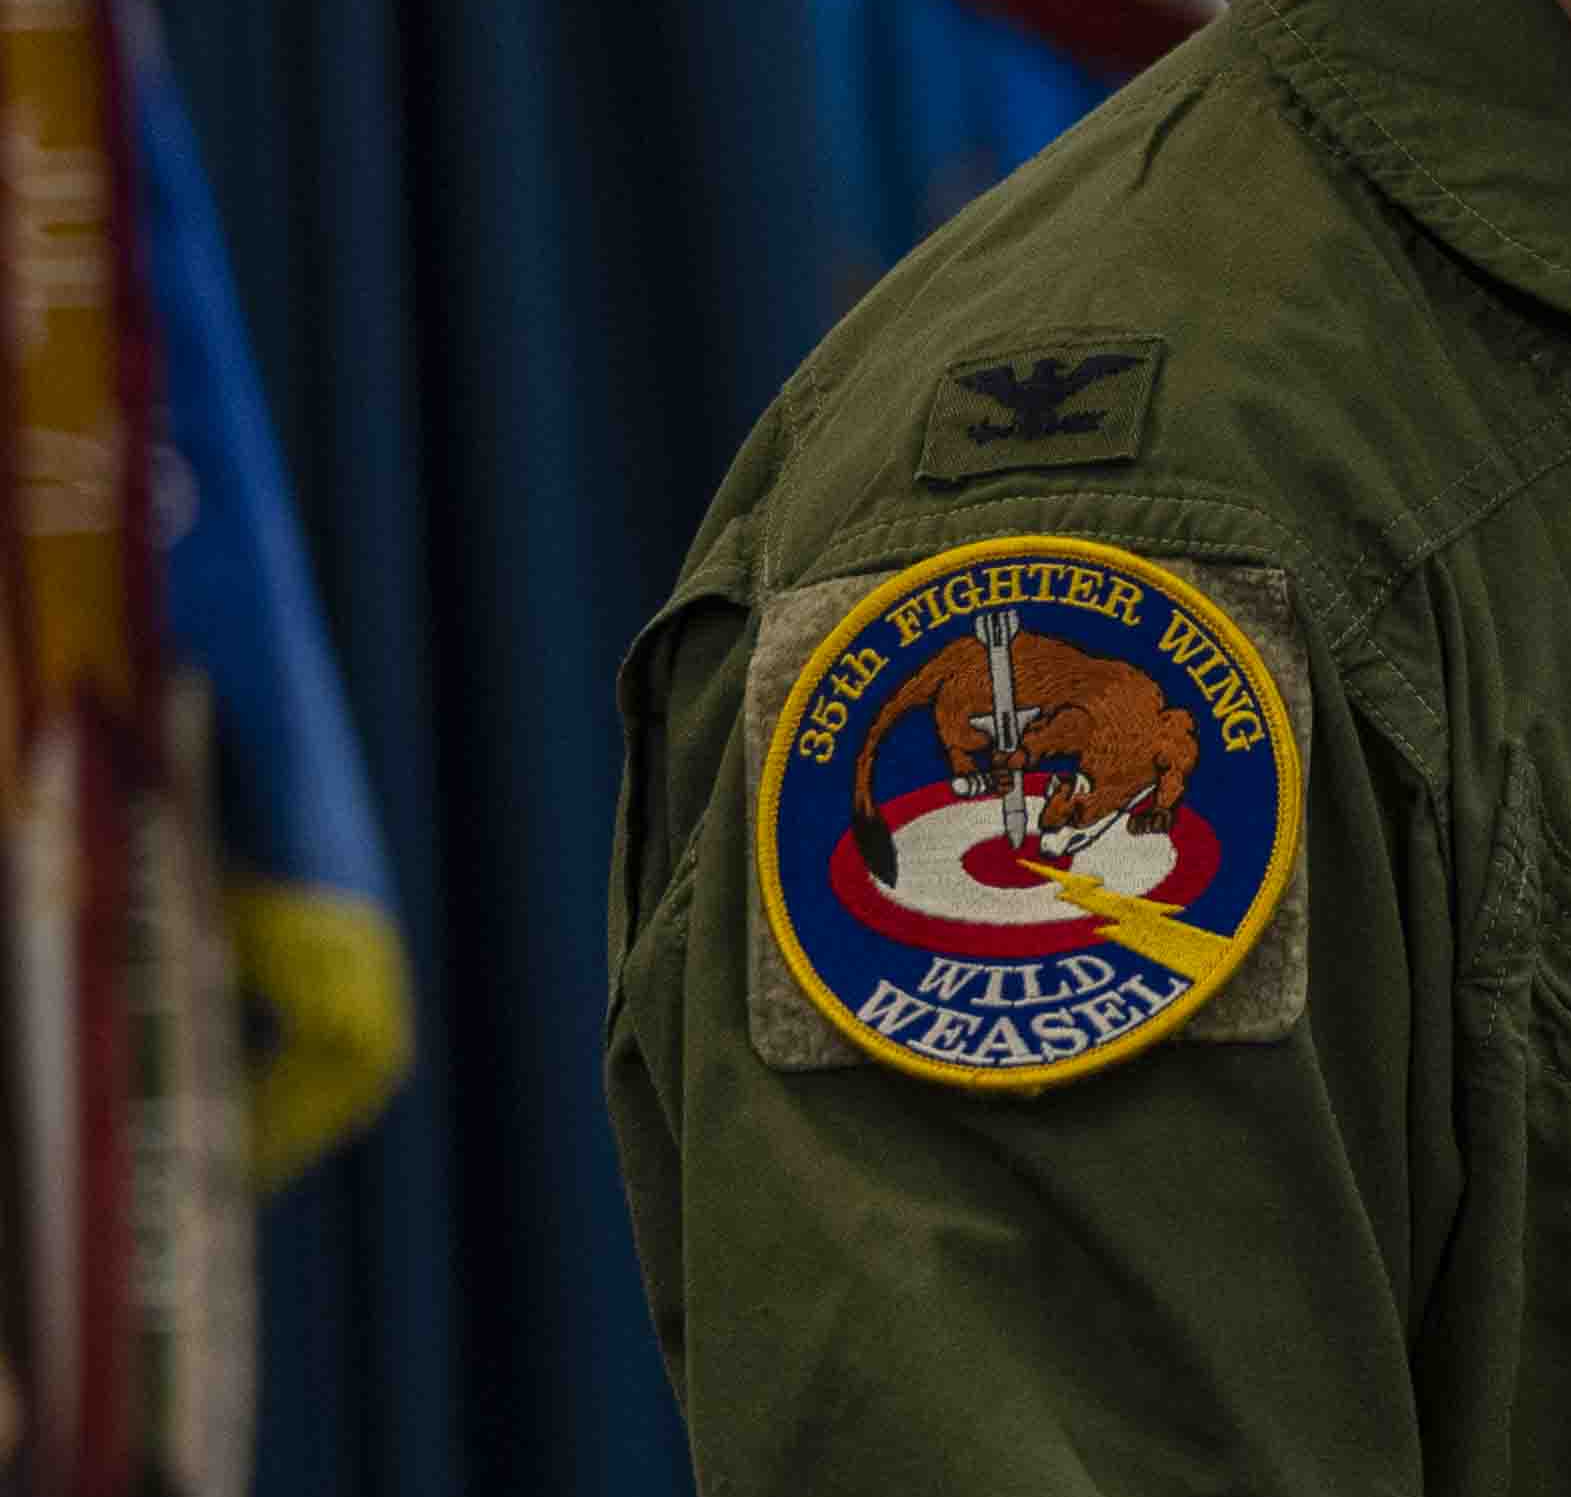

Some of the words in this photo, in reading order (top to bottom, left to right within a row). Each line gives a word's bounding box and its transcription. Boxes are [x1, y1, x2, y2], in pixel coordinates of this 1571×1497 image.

[799, 642, 890, 766] 35th
[884, 562, 1145, 649] FIGHTER
[1153, 605, 1266, 753] WING
[855, 973, 1195, 1066] WEASEL
[916, 954, 1116, 1008] WILD
